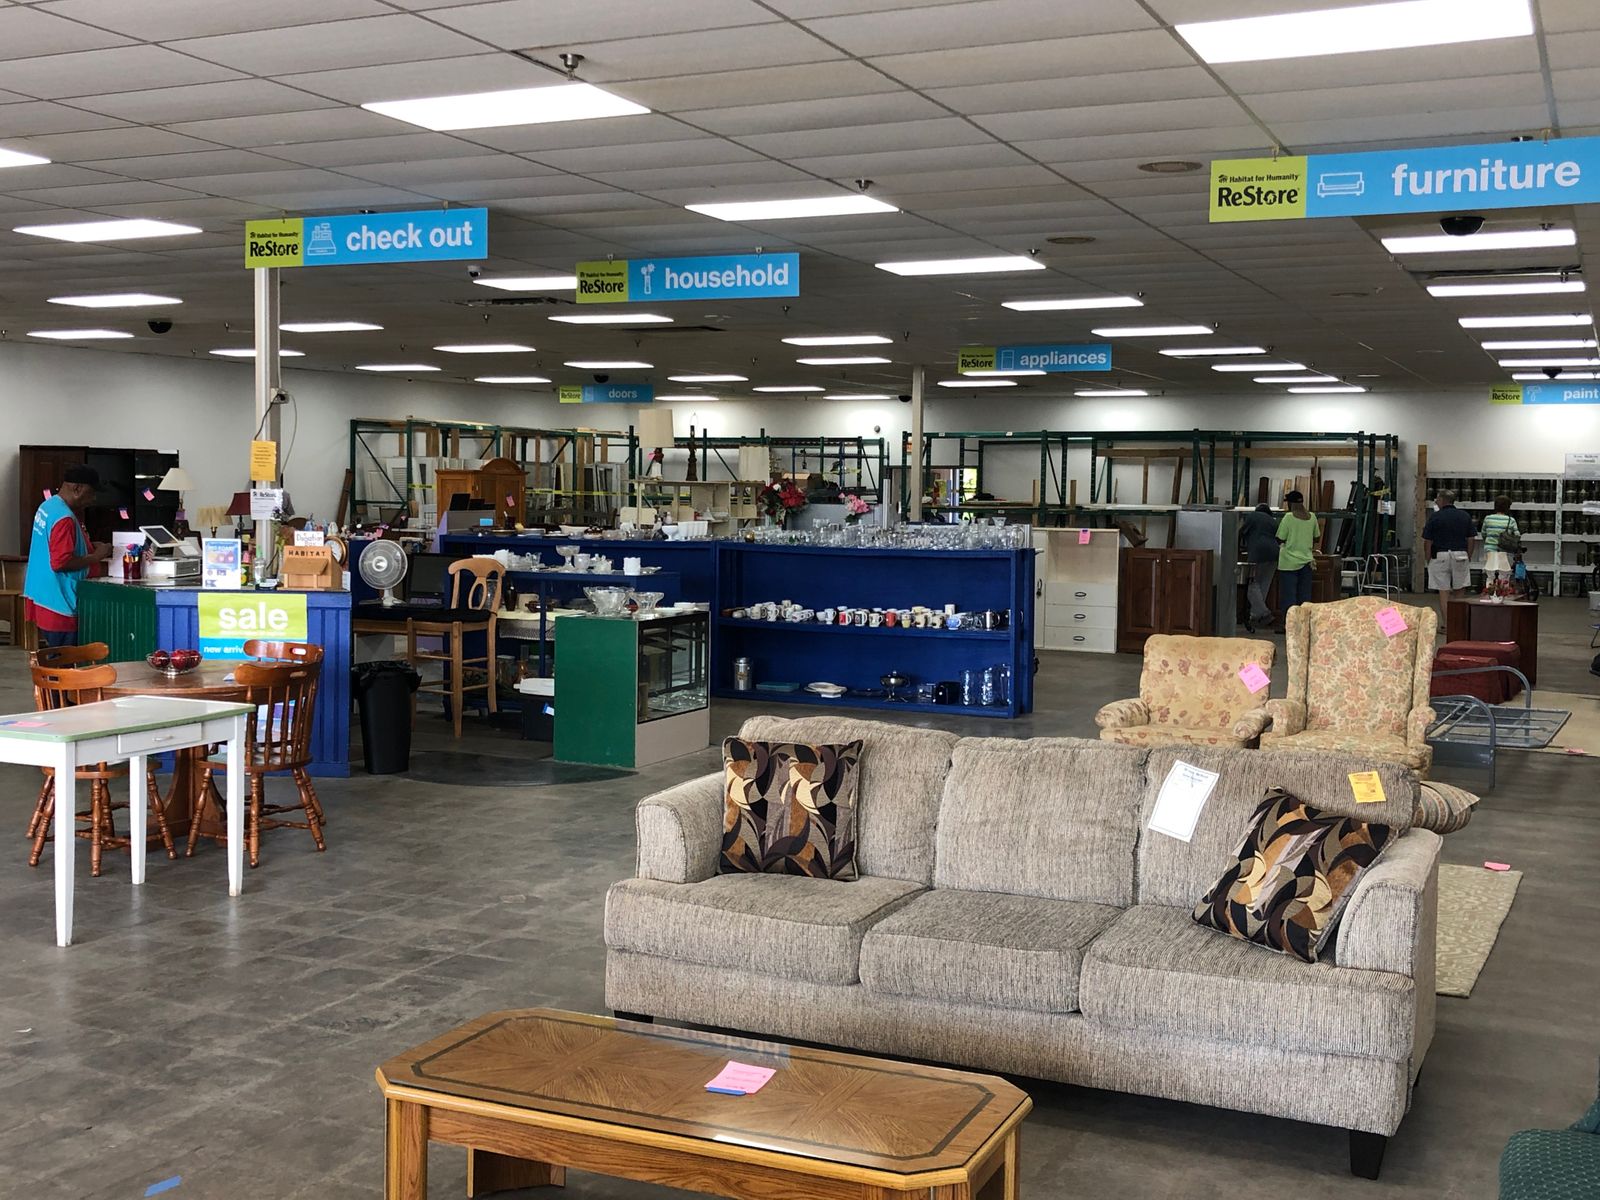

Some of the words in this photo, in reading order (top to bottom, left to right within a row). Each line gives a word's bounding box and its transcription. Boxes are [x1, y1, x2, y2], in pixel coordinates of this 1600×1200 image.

[1229, 175, 1253, 183] Habitat
[1255, 174, 1265, 182] for
[1266, 173, 1299, 182] Humanity
[1392, 158, 1581, 196] furniture
[1217, 185, 1298, 207] ReStore
[346, 222, 422, 251] check
[429, 220, 473, 248] out
[250, 240, 298, 257] ReStore
[665, 263, 789, 289] household
[580, 279, 624, 293] ReStore
[961, 358, 993, 368] ReStore
[1020, 351, 1107, 368] appliances
[608, 388, 638, 398] doors
[1492, 392, 1520, 400] ReStore
[1563, 388, 1599, 403] paint
[288, 549, 326, 557] HABITAT
[218, 601, 289, 631] sale
[223, 645, 244, 654] arriv
